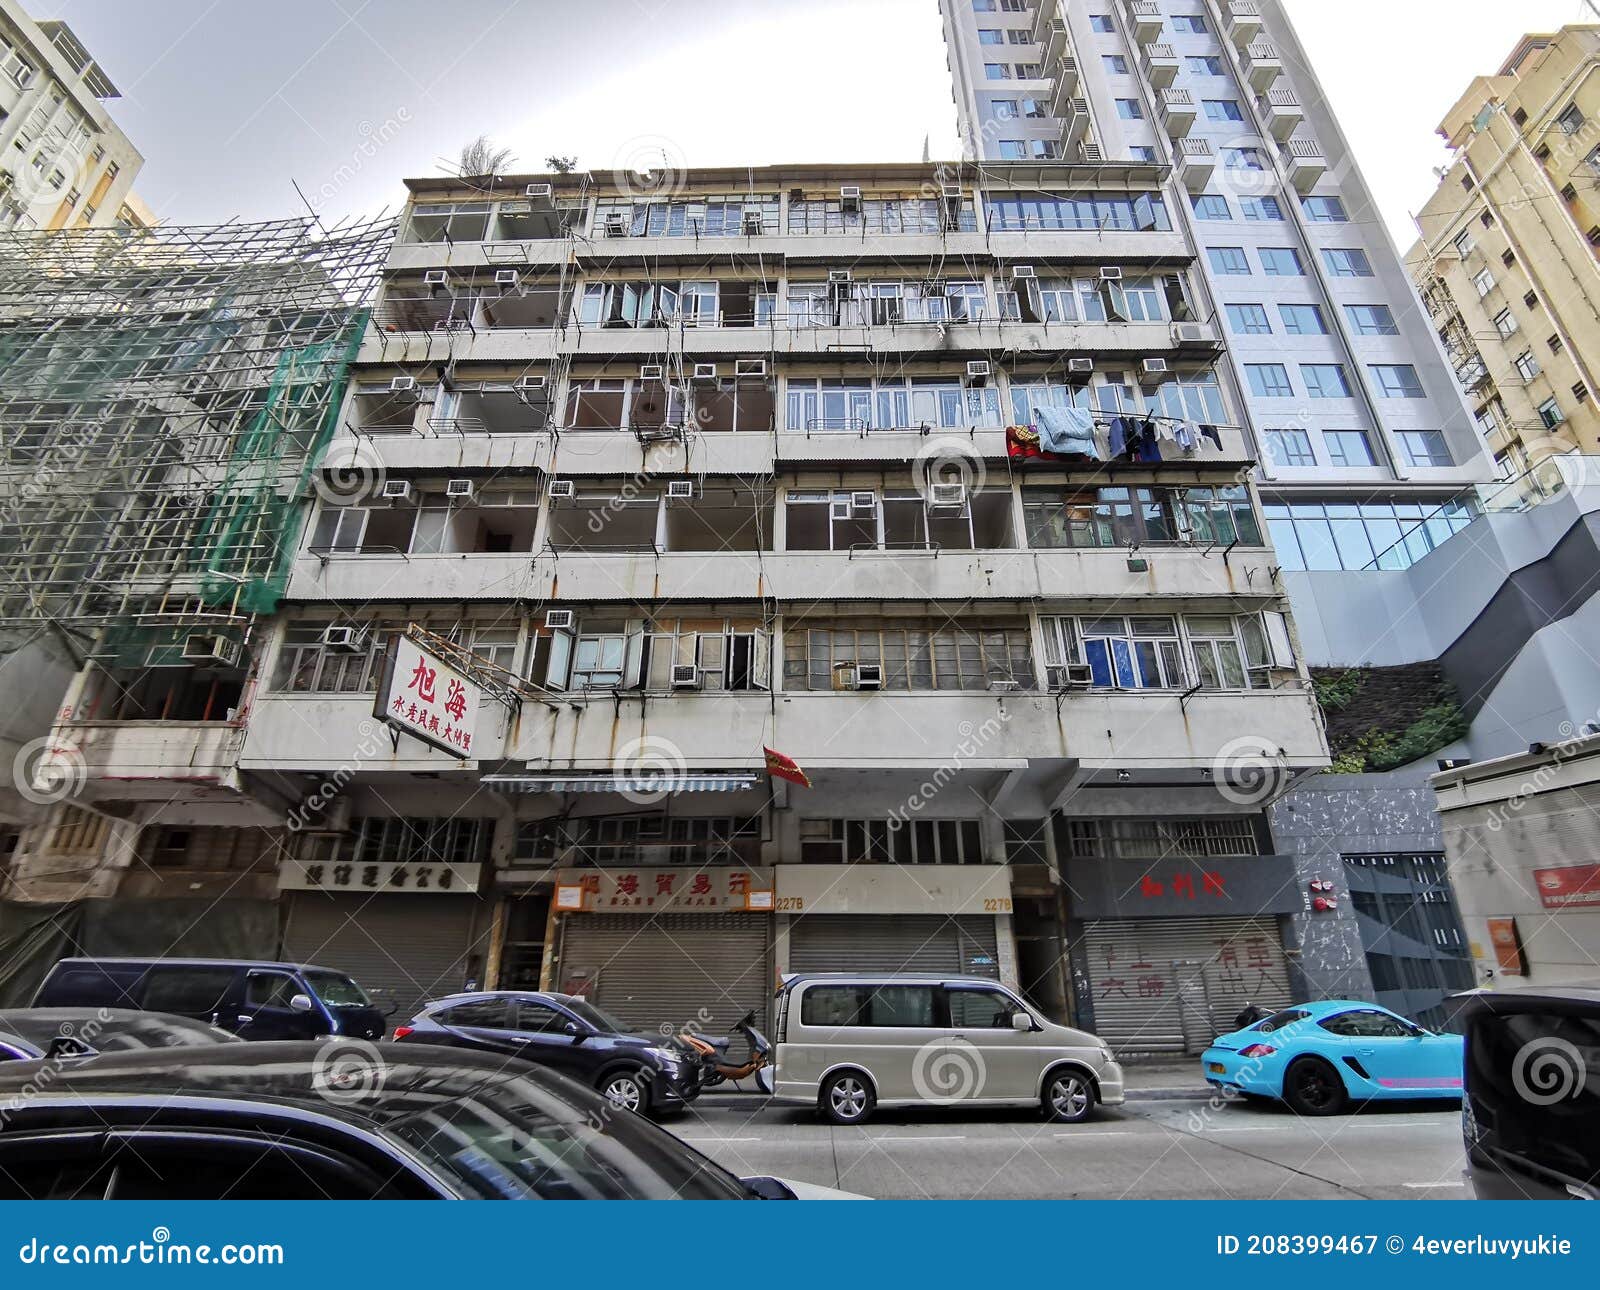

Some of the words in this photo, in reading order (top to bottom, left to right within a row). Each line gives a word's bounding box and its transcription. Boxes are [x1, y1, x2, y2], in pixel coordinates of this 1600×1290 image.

[408, 655, 467, 722] 旭海
[776, 897, 803, 911] 227B
[984, 898, 1011, 911] 227B
